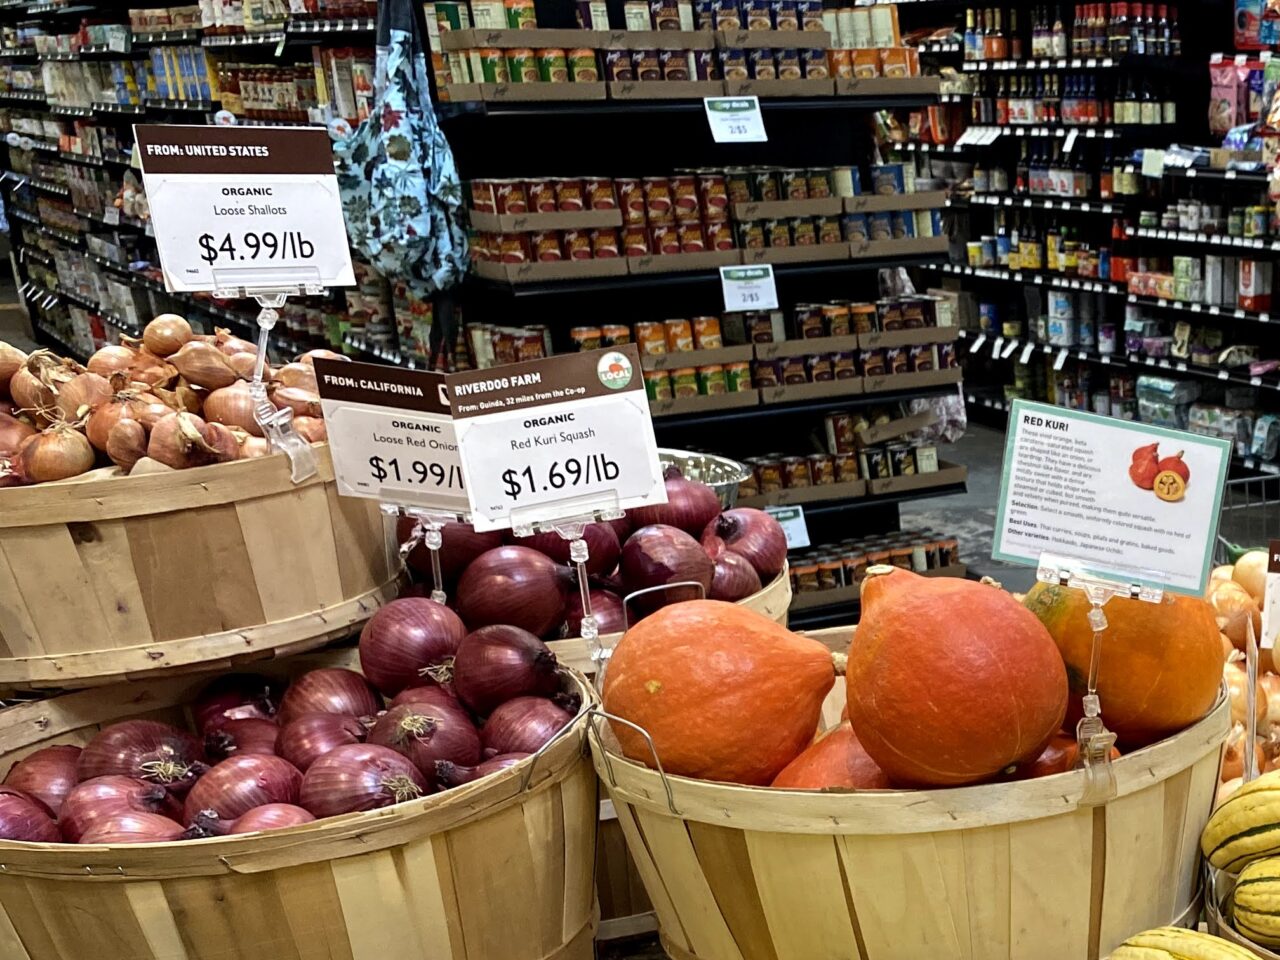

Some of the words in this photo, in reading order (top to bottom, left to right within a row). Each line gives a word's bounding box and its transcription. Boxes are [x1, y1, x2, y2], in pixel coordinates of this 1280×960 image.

[147, 145, 184, 156] FROM:
[187, 145, 227, 156] UNITED
[229, 146, 269, 157] STATES
[221, 188, 273, 196] ORGANIC
[213, 205, 245, 215] Loose
[249, 205, 287, 215] Shallots
[198, 232, 315, 266] $4.99/lb
[601, 370, 630, 381] LOCAL
[324, 375, 358, 388] FROM:
[360, 380, 423, 397] CALIFORNIA
[454, 378, 509, 396] RIVERDOG
[510, 372, 541, 387] FARM
[458, 404, 479, 413] From:
[505, 397, 515, 406] 32
[515, 394, 535, 404] miles
[535, 392, 552, 401] from
[552, 389, 564, 398] the
[565, 386, 586, 398] Co-op
[392, 420, 442, 434] ORGANIC
[523, 413, 575, 429] ORGANIC
[1024, 415, 1043, 426] RED
[1045, 419, 1069, 431] KURI
[373, 433, 404, 445] Loose
[406, 436, 426, 448] Red
[510, 439, 531, 451] Red
[534, 435, 557, 447] Kuri
[559, 428, 595, 444] Squash
[369, 456, 463, 489] $1.99/l
[502, 453, 620, 501] $1.69/lb
[1008, 528, 1024, 536] Other
